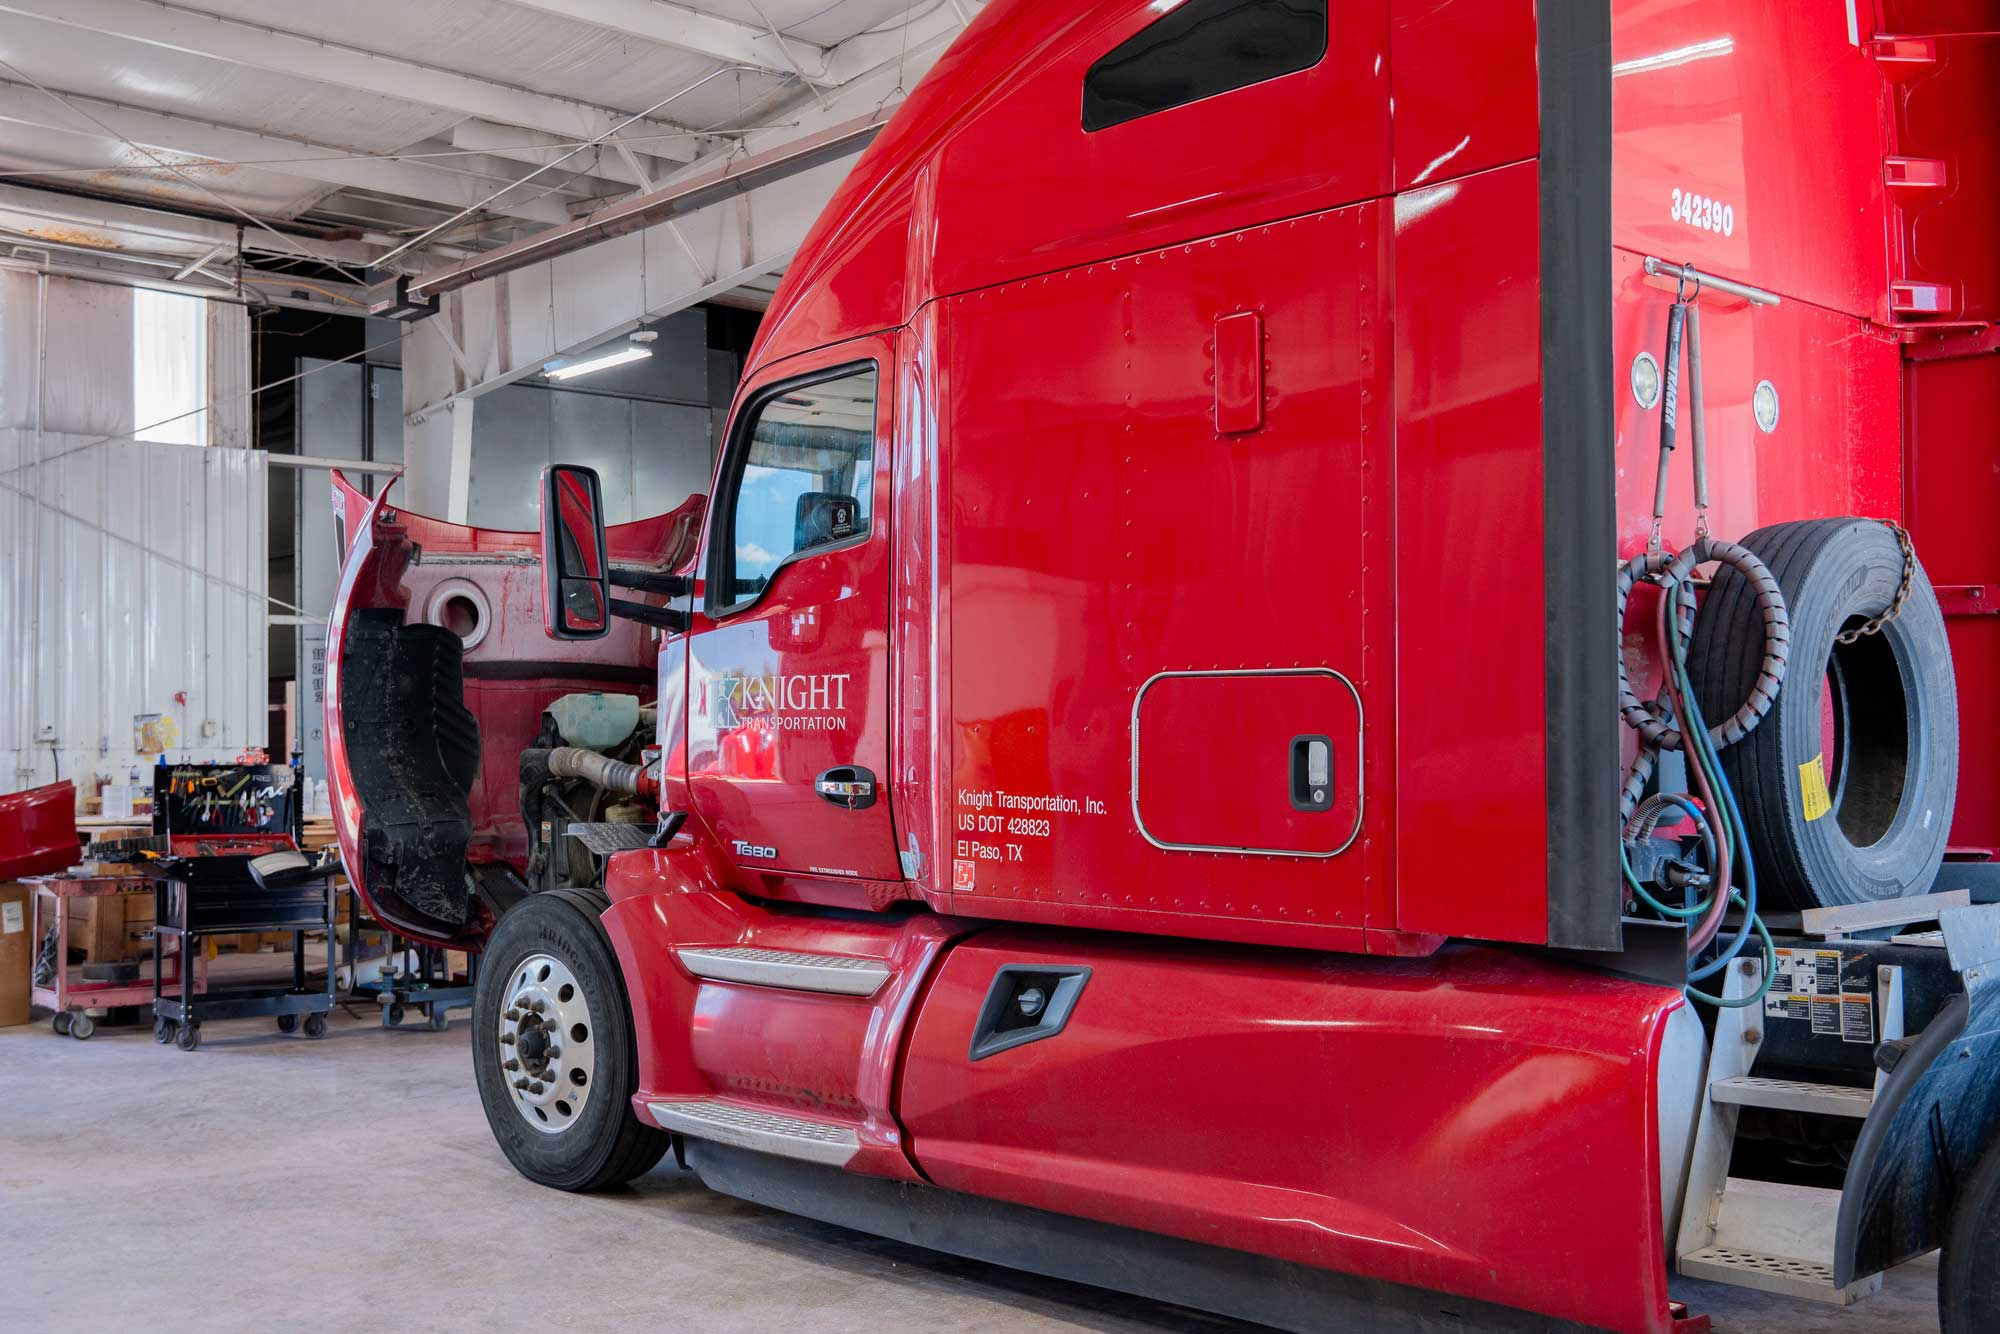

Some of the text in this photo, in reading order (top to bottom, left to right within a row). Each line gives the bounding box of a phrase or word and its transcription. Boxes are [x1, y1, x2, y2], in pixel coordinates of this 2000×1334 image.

[1671, 187, 1733, 238] 342390
[741, 673, 850, 710] KNIGHT
[740, 716, 846, 730] TRANSPORTATION
[958, 789, 1107, 816] Knight Transportation, Inc.
[958, 814, 1050, 836] US DOT 428823
[732, 840, 776, 858] T680
[957, 840, 1023, 863] El Paso, TX
